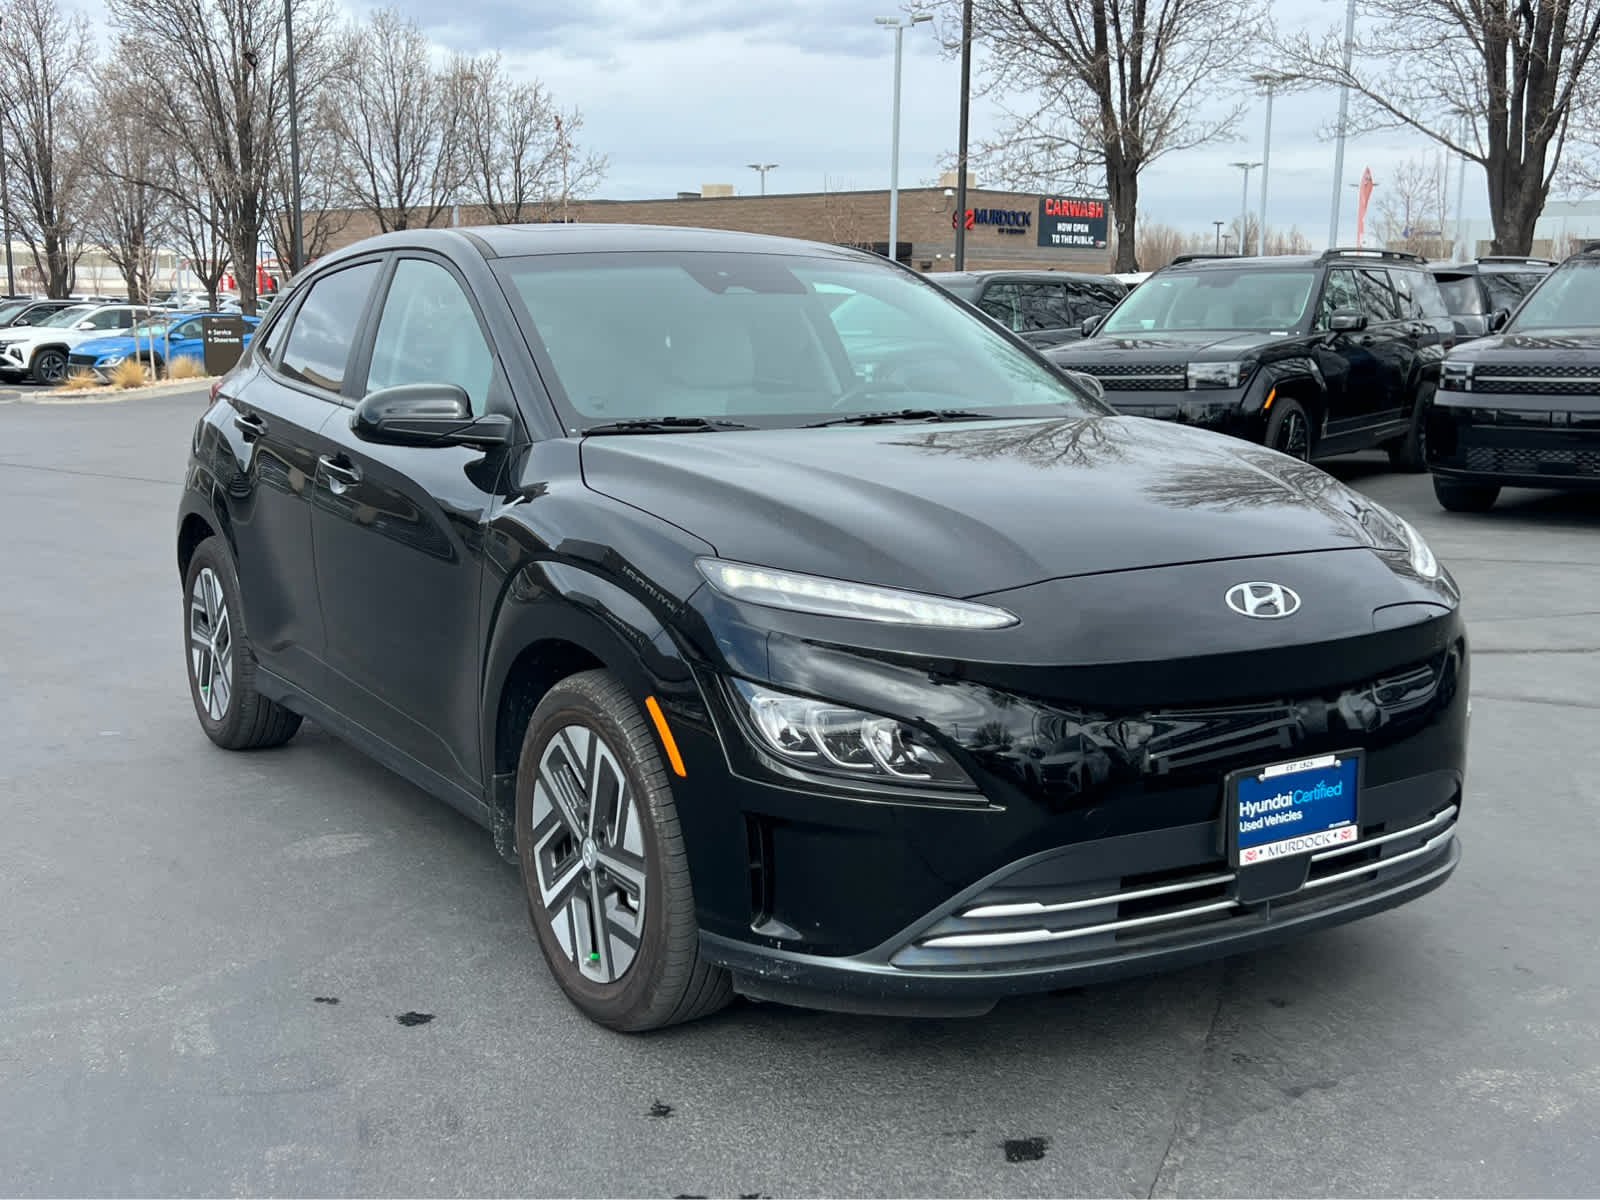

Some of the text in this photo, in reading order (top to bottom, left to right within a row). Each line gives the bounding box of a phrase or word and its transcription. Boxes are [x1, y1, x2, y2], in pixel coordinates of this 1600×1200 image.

[974, 208, 1031, 227] MURDOCK
[1045, 198, 1104, 218] CARWASH
[1057, 222, 1089, 233] NOW OPEN
[1052, 234, 1061, 244] TO
[1061, 234, 1073, 244] THE
[1073, 235, 1094, 245] PUBLIC
[1240, 810, 1303, 832] Used Vehicles
[1267, 833, 1331, 857] MURDOCK
